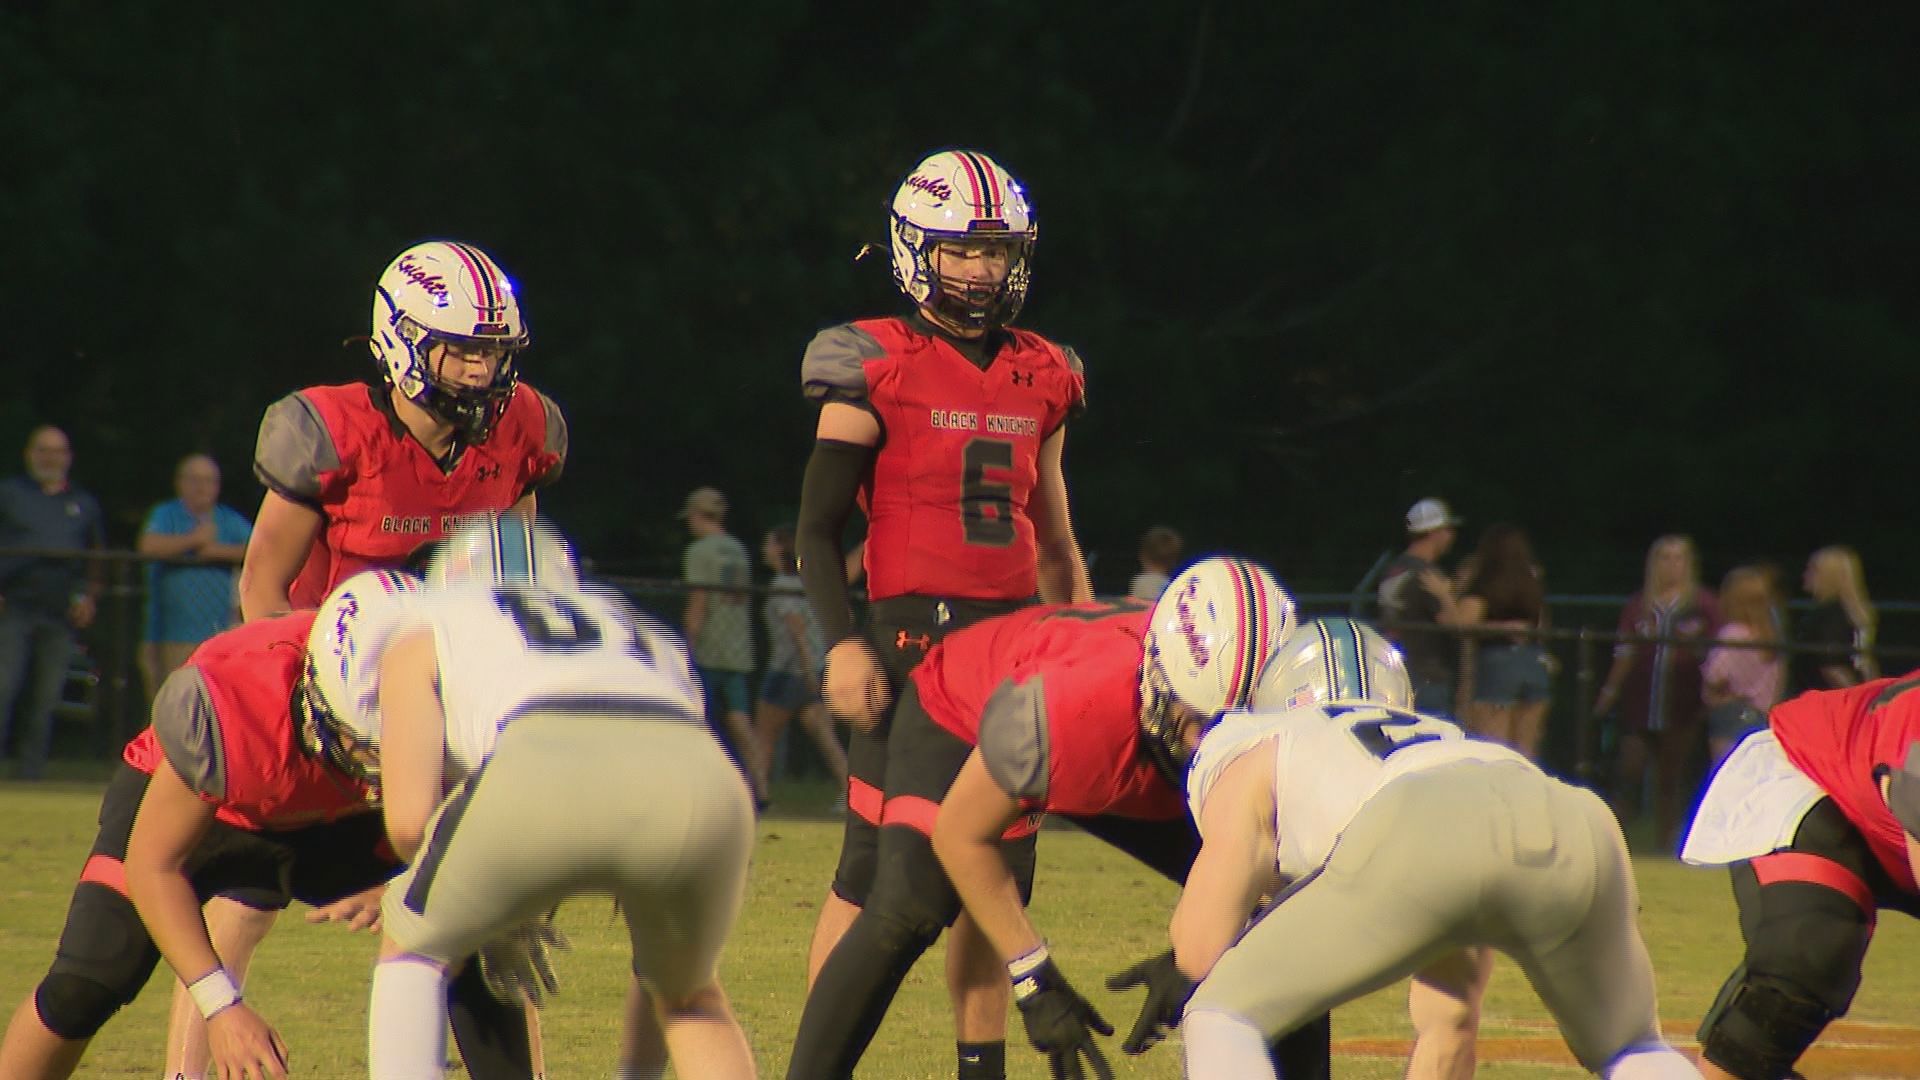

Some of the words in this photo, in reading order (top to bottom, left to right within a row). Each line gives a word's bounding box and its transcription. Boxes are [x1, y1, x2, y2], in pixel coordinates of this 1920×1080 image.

[931, 409, 977, 430] BLACK
[986, 414, 1037, 436] KNIGHTS
[961, 437, 1018, 546] 6
[381, 515, 431, 534] BLACK
